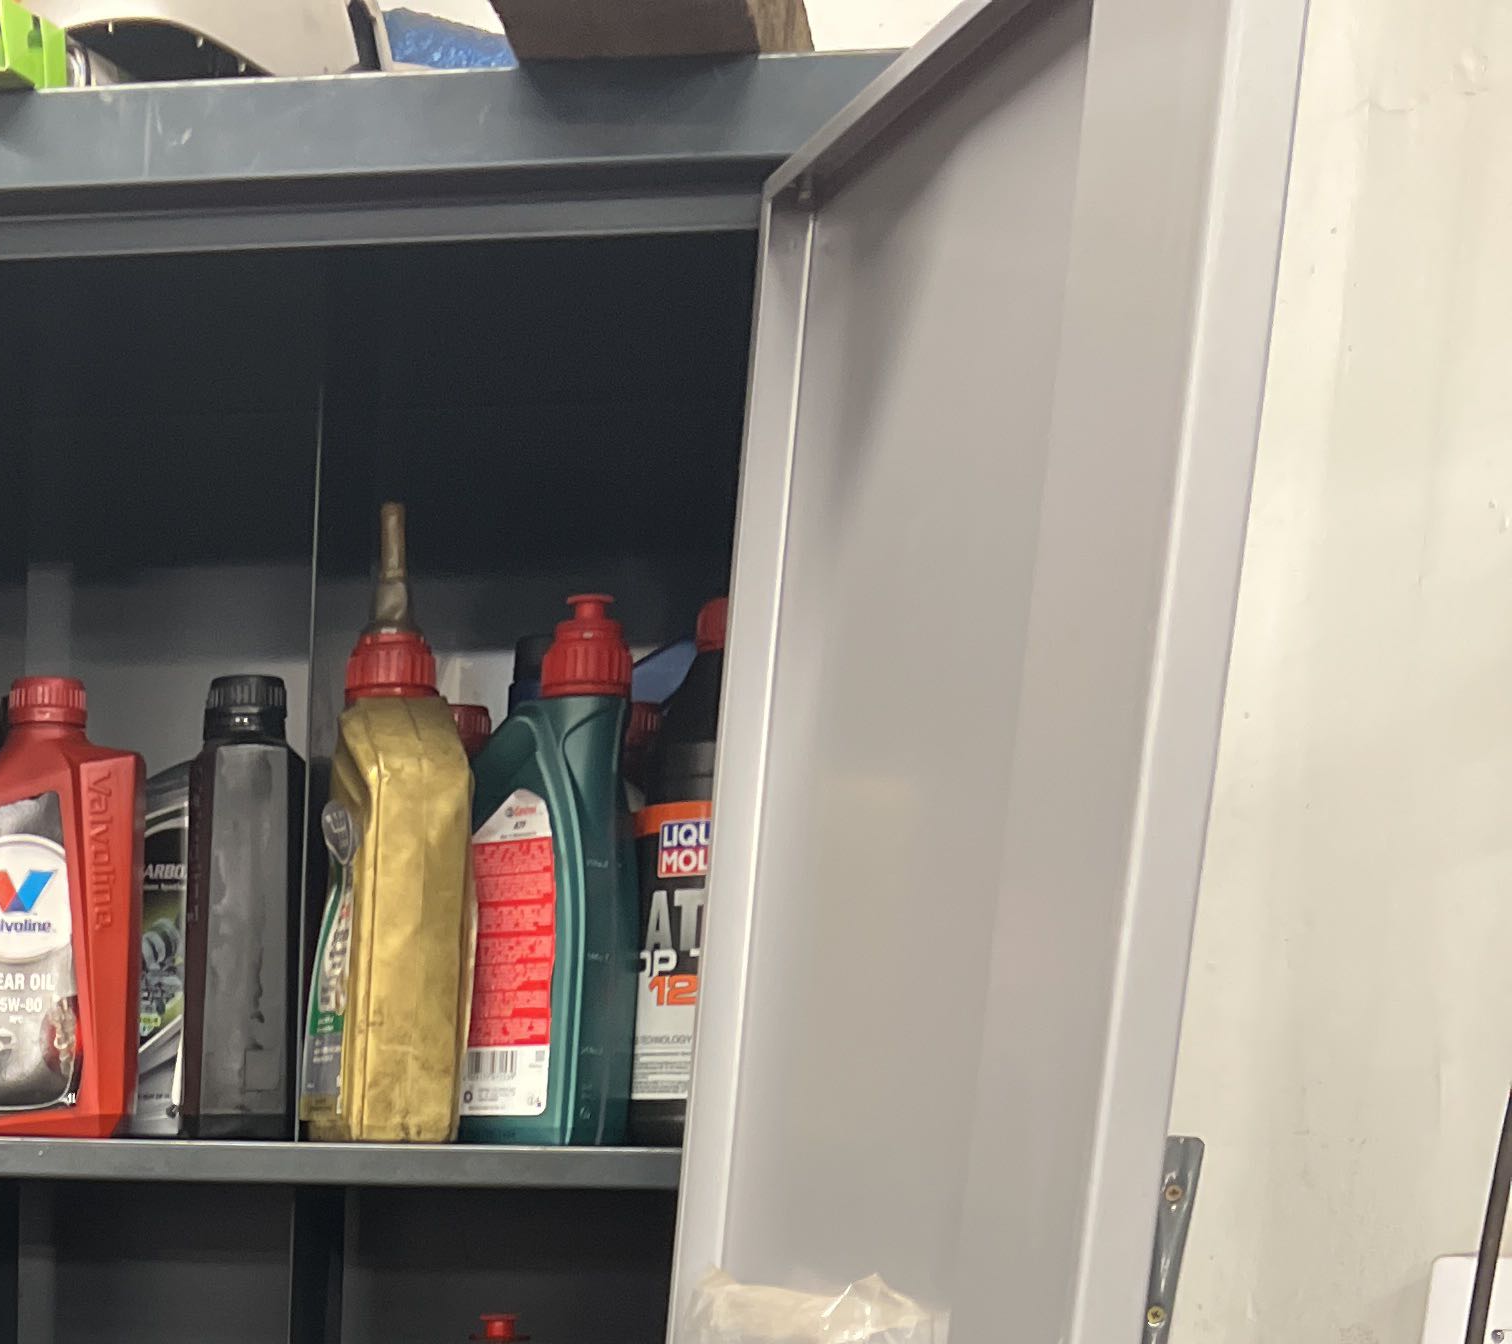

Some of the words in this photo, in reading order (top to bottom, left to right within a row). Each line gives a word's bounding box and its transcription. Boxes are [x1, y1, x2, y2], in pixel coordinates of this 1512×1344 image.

[662, 821, 712, 847] LIQU
[661, 849, 709, 874] MOL
[644, 888, 707, 951] AT
[29, 971, 57, 991] OIL
[648, 975, 699, 1007] 12
